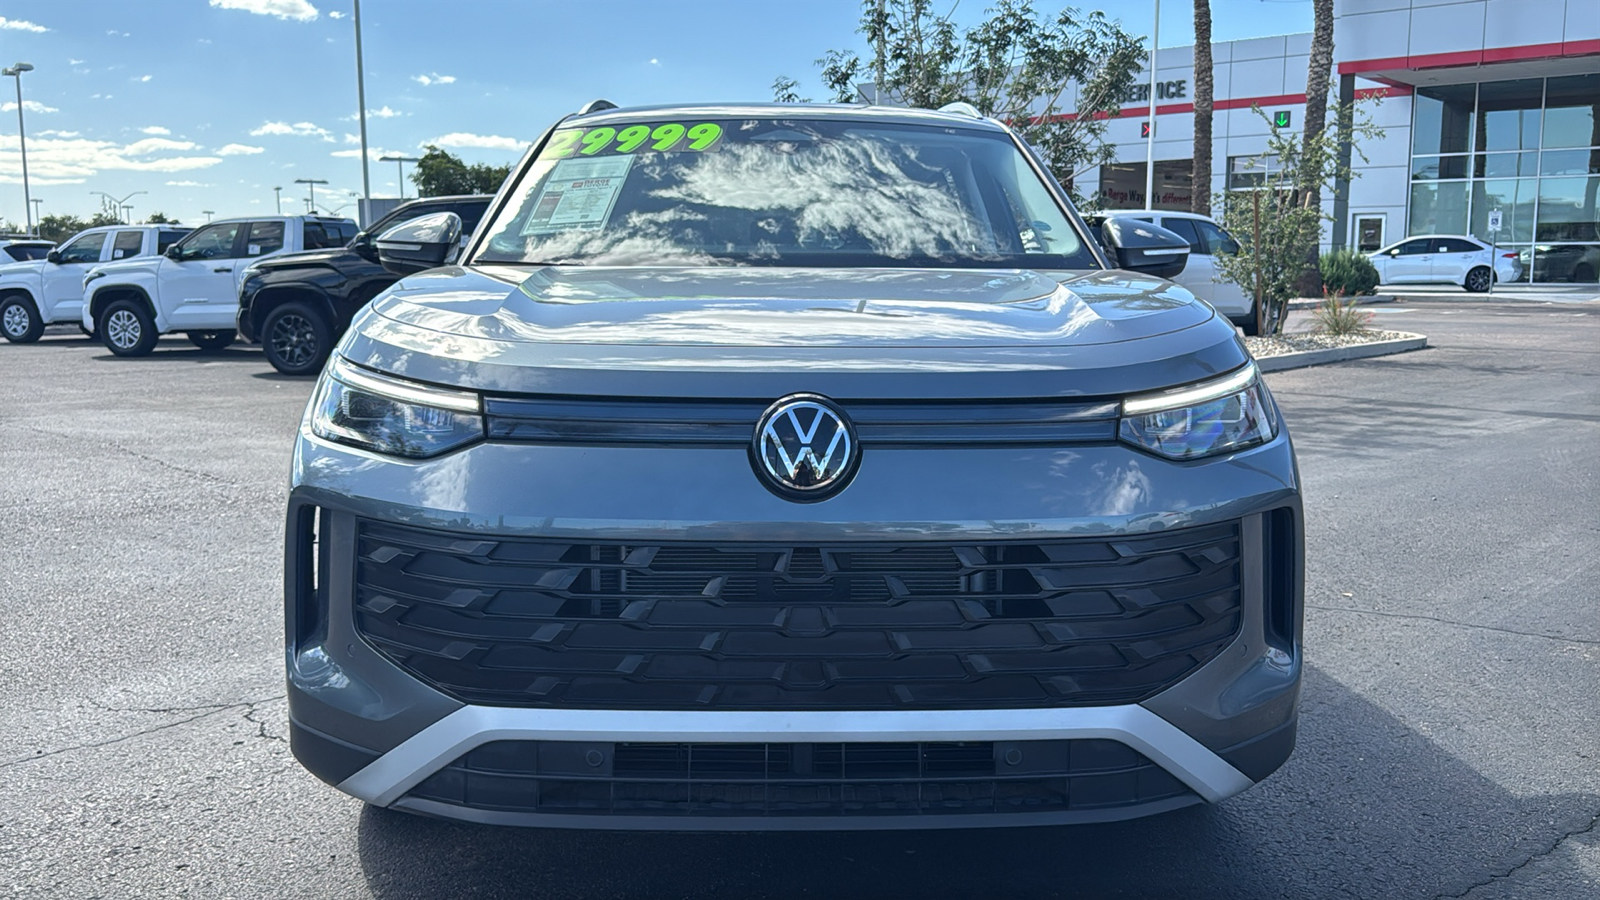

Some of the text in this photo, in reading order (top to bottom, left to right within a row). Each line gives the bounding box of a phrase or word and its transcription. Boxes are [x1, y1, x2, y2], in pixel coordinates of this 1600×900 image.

[544, 123, 723, 157] 29999
[1108, 187, 1128, 203] Berge
[761, 400, 850, 490] VW
